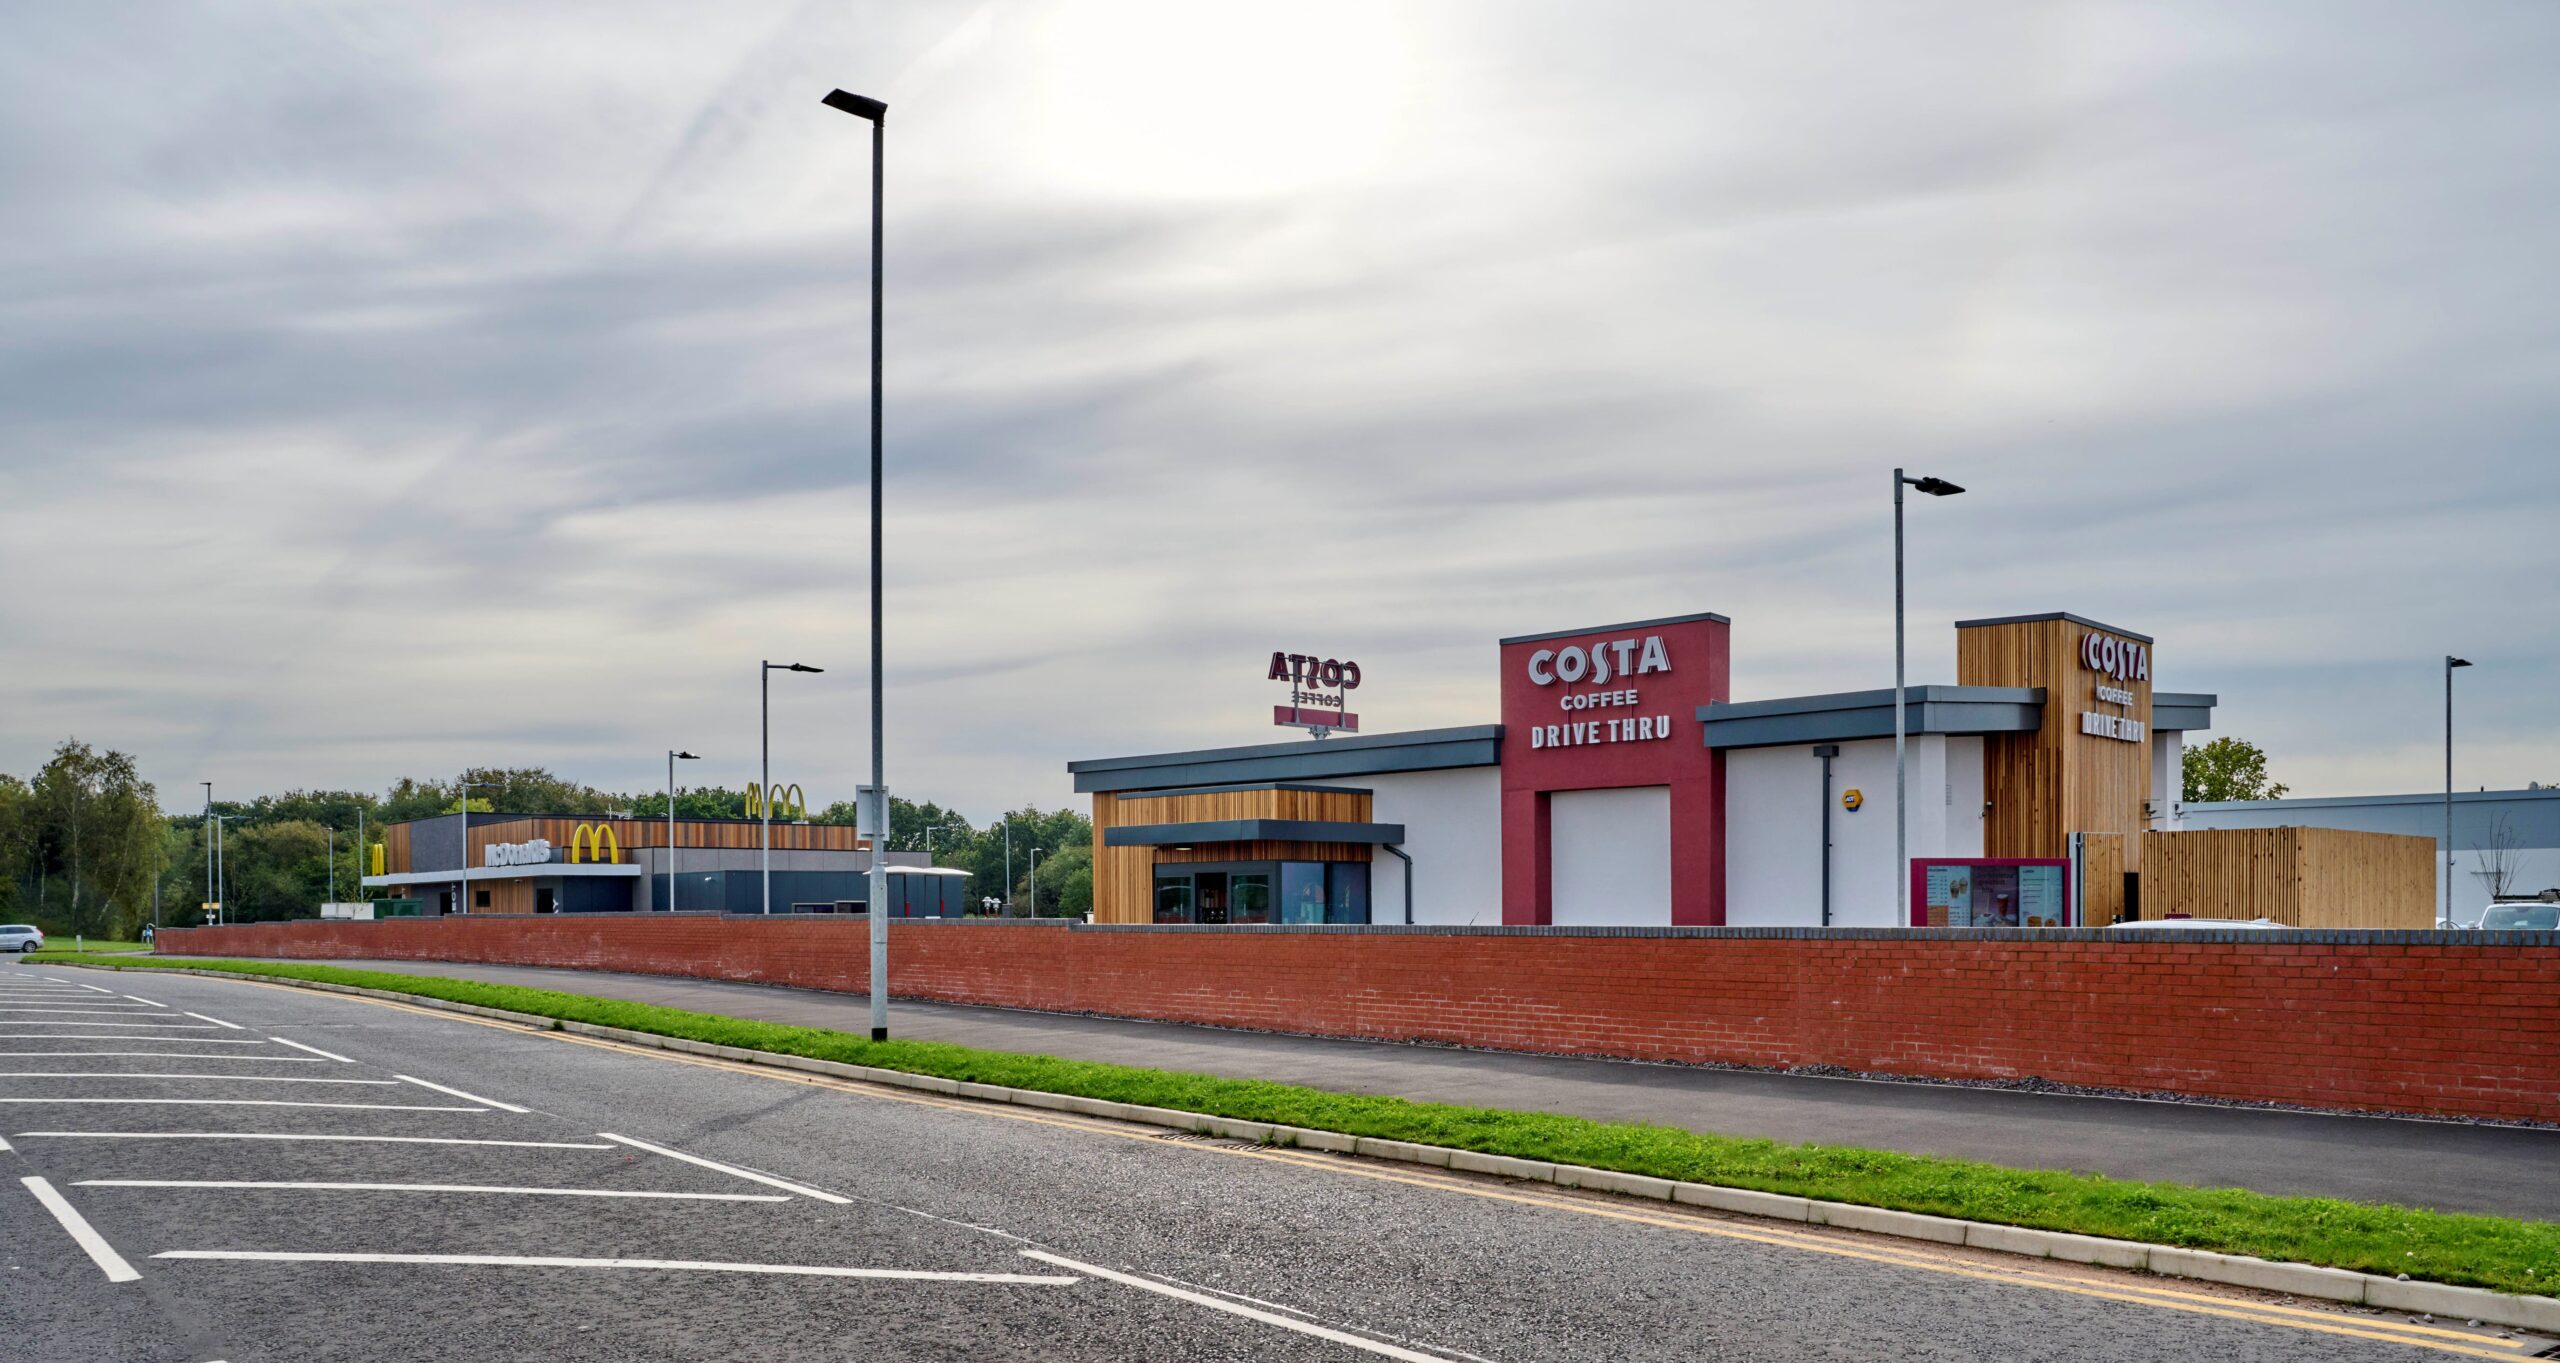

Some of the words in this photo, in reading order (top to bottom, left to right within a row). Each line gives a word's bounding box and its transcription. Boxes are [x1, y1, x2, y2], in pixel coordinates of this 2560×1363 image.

[1528, 635, 1672, 685] COSTA
[2082, 632, 2148, 681] COSTA
[1560, 689, 1639, 711] COFFEE
[2096, 686, 2134, 706] COFFEE
[1532, 721, 1601, 749] DRIVE
[1608, 715, 1670, 742] THRU
[2082, 711, 2118, 738] DRIVE
[2117, 718, 2145, 743] THRU
